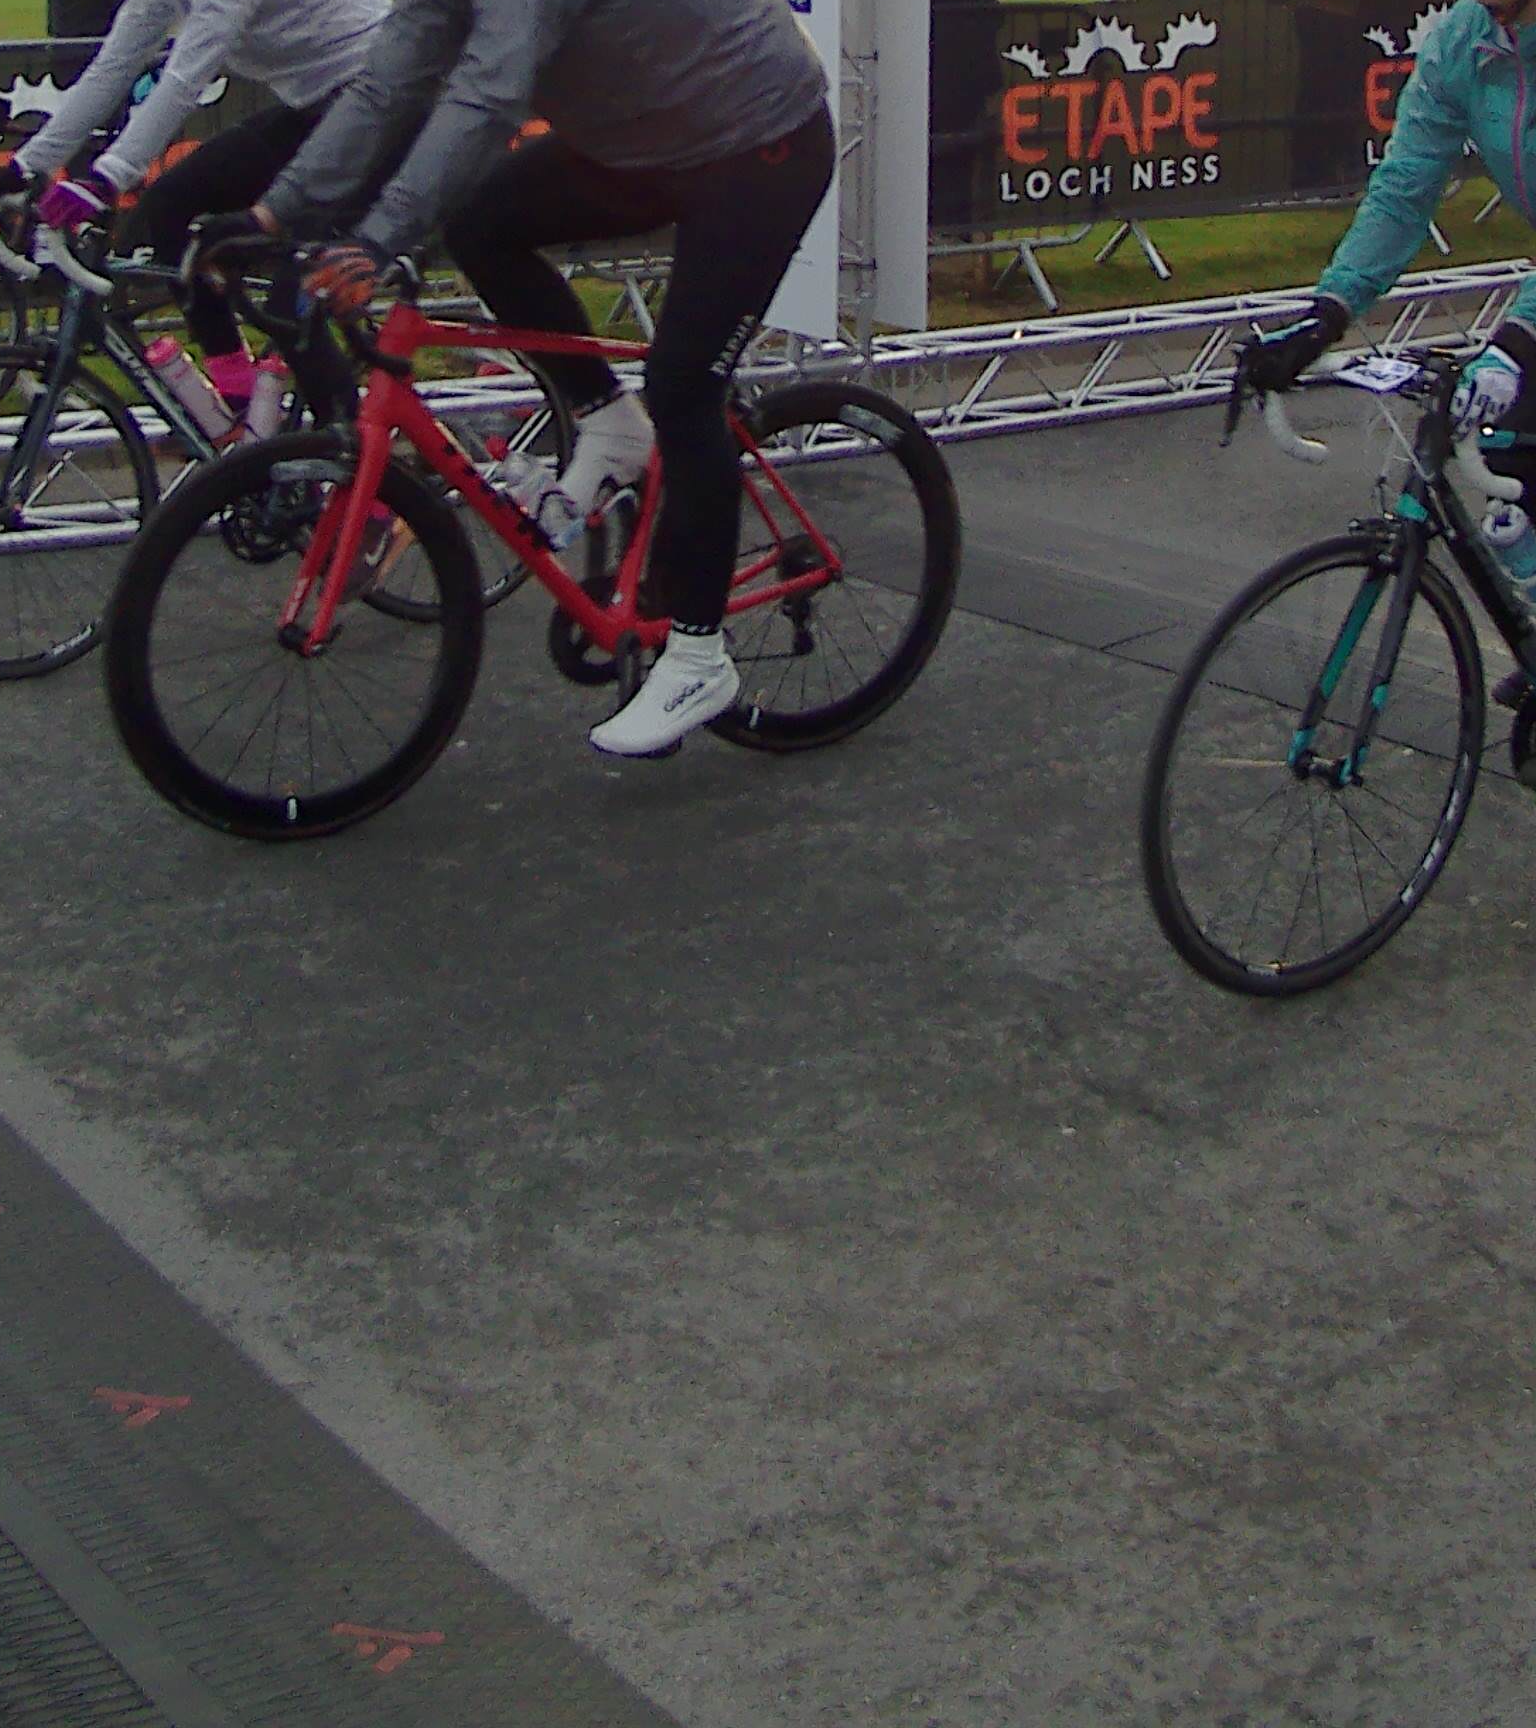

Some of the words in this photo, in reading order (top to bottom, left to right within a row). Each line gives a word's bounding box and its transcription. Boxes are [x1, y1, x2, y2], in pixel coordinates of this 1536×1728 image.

[1001, 71, 1220, 166] ETAPE
[1000, 164, 1111, 203] LOCH
[1132, 154, 1221, 192] NESS
